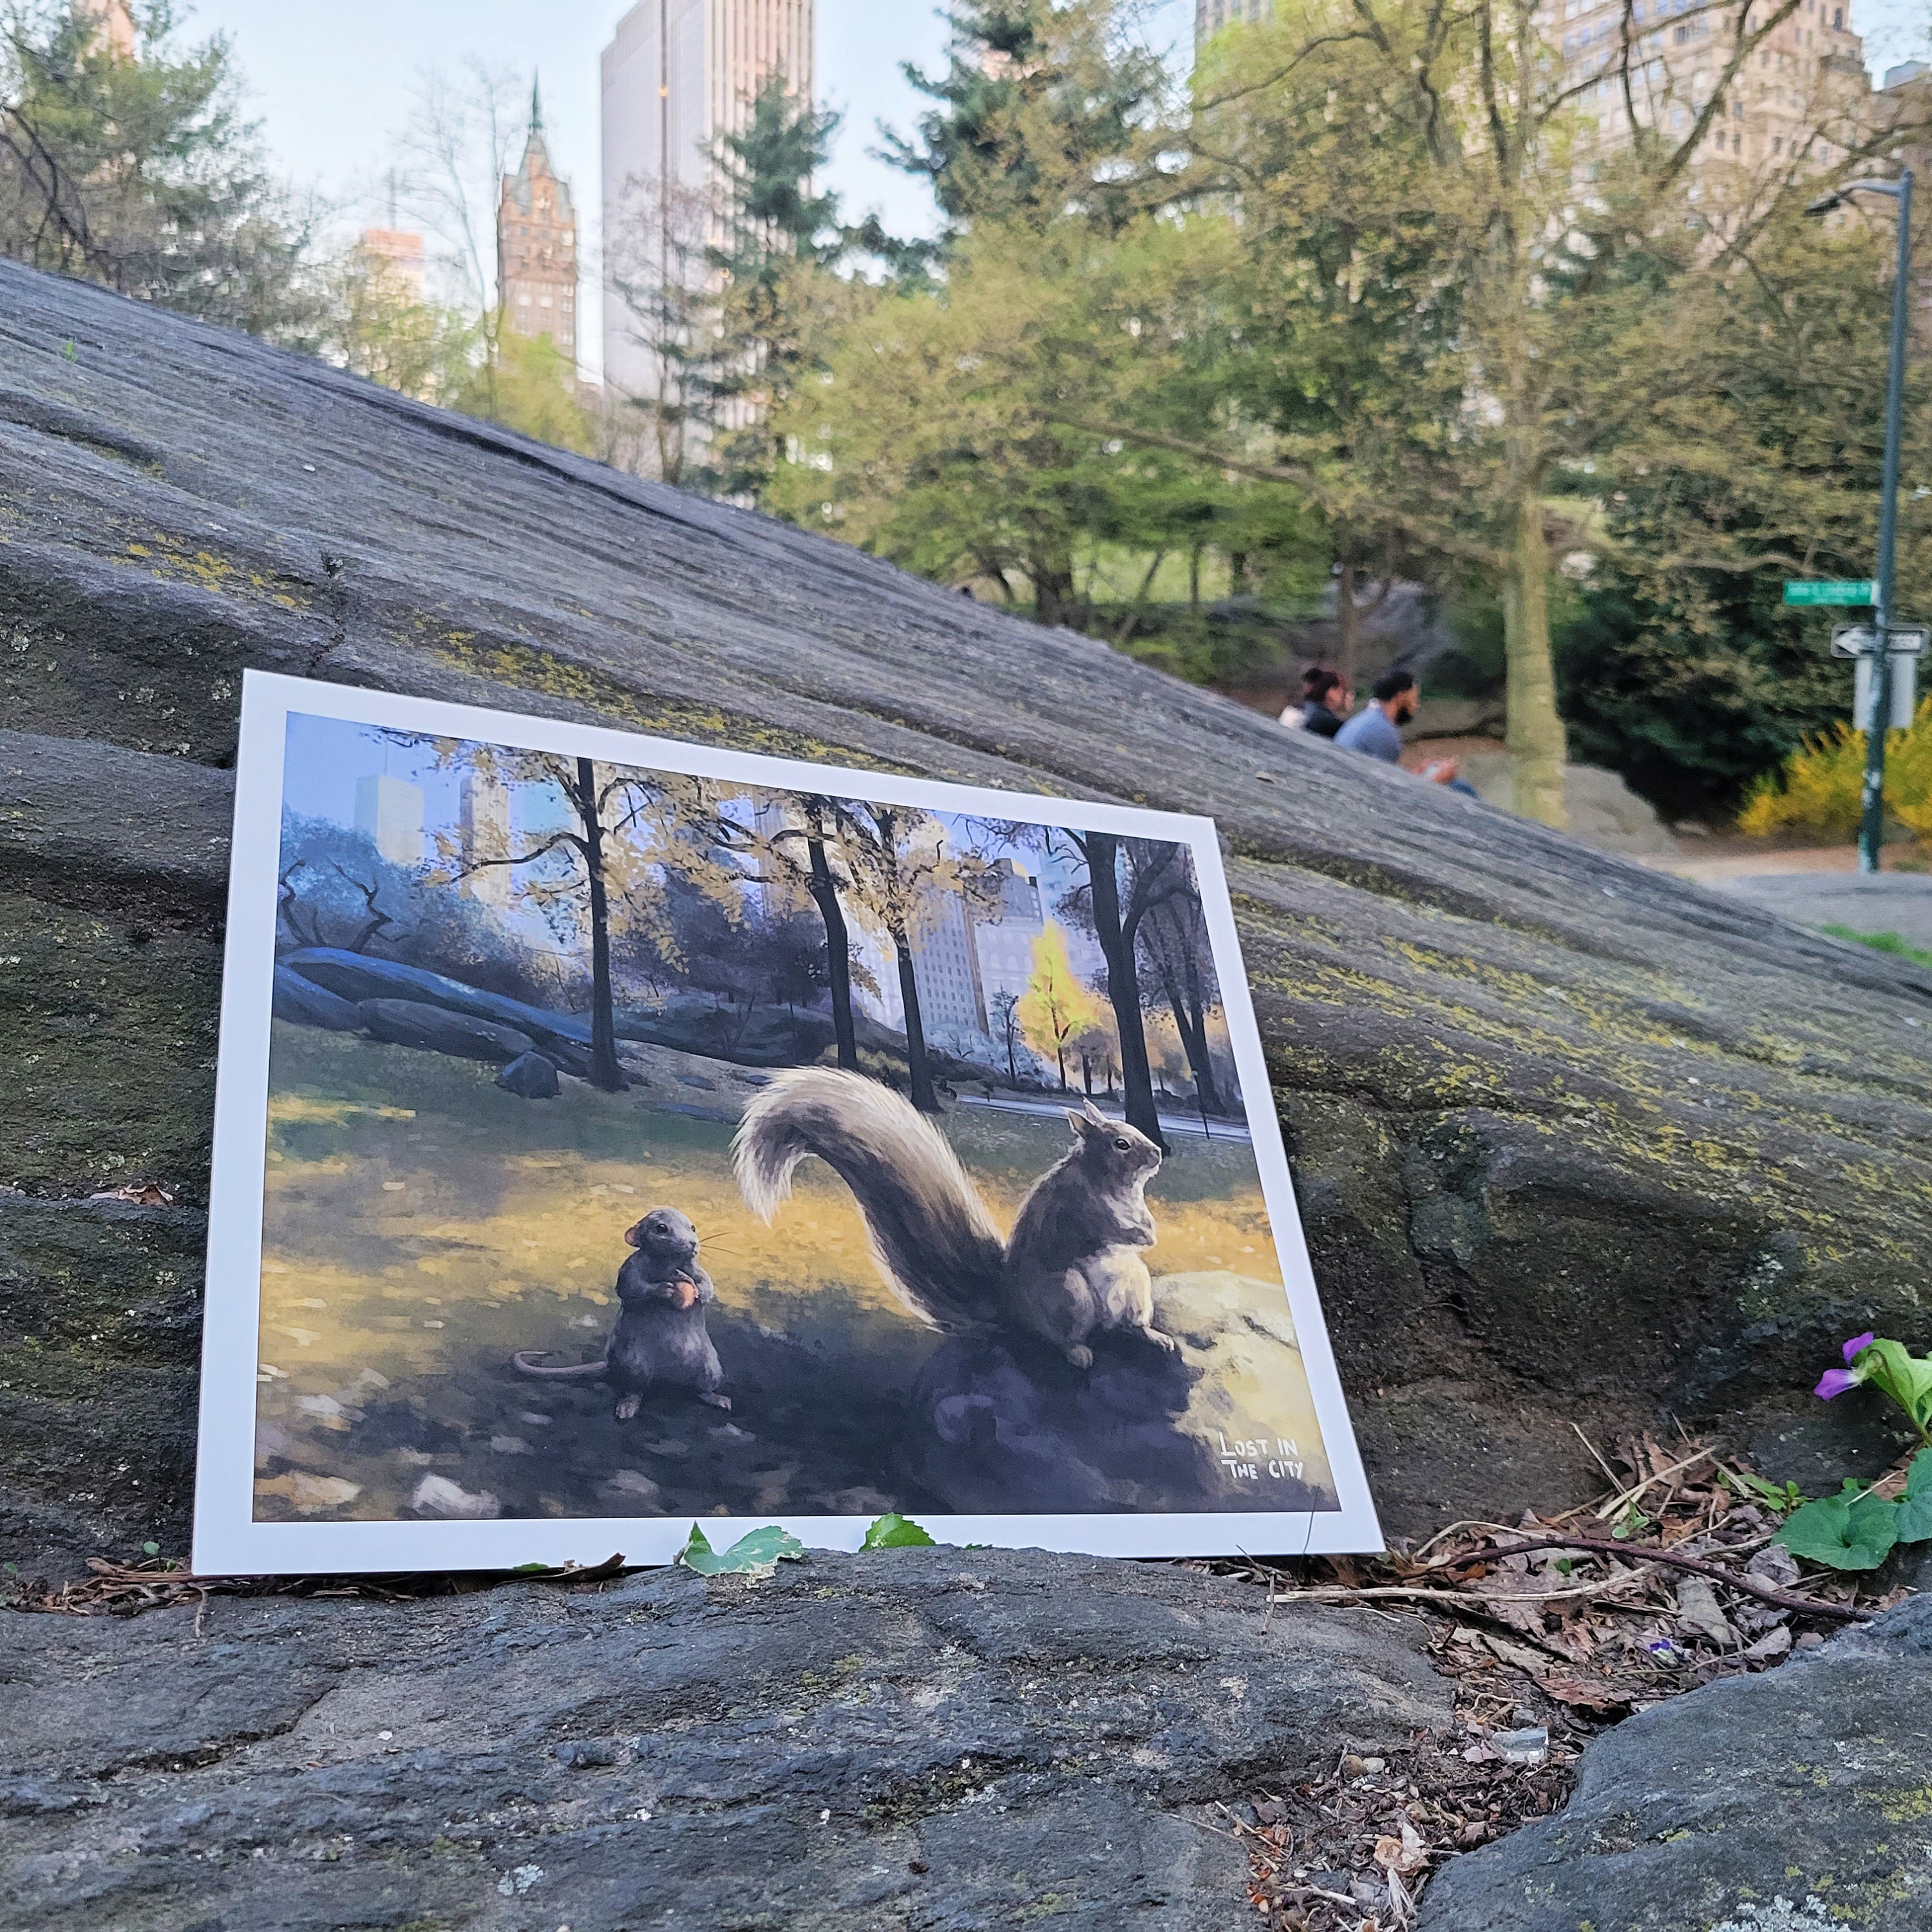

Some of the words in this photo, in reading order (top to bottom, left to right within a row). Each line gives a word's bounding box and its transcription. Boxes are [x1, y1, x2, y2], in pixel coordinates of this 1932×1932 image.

[1219, 1431, 1267, 1456] LOST
[1277, 1437, 1298, 1456] IN
[1221, 1459, 1258, 1479] THE
[1268, 1459, 1303, 1479] CITY
